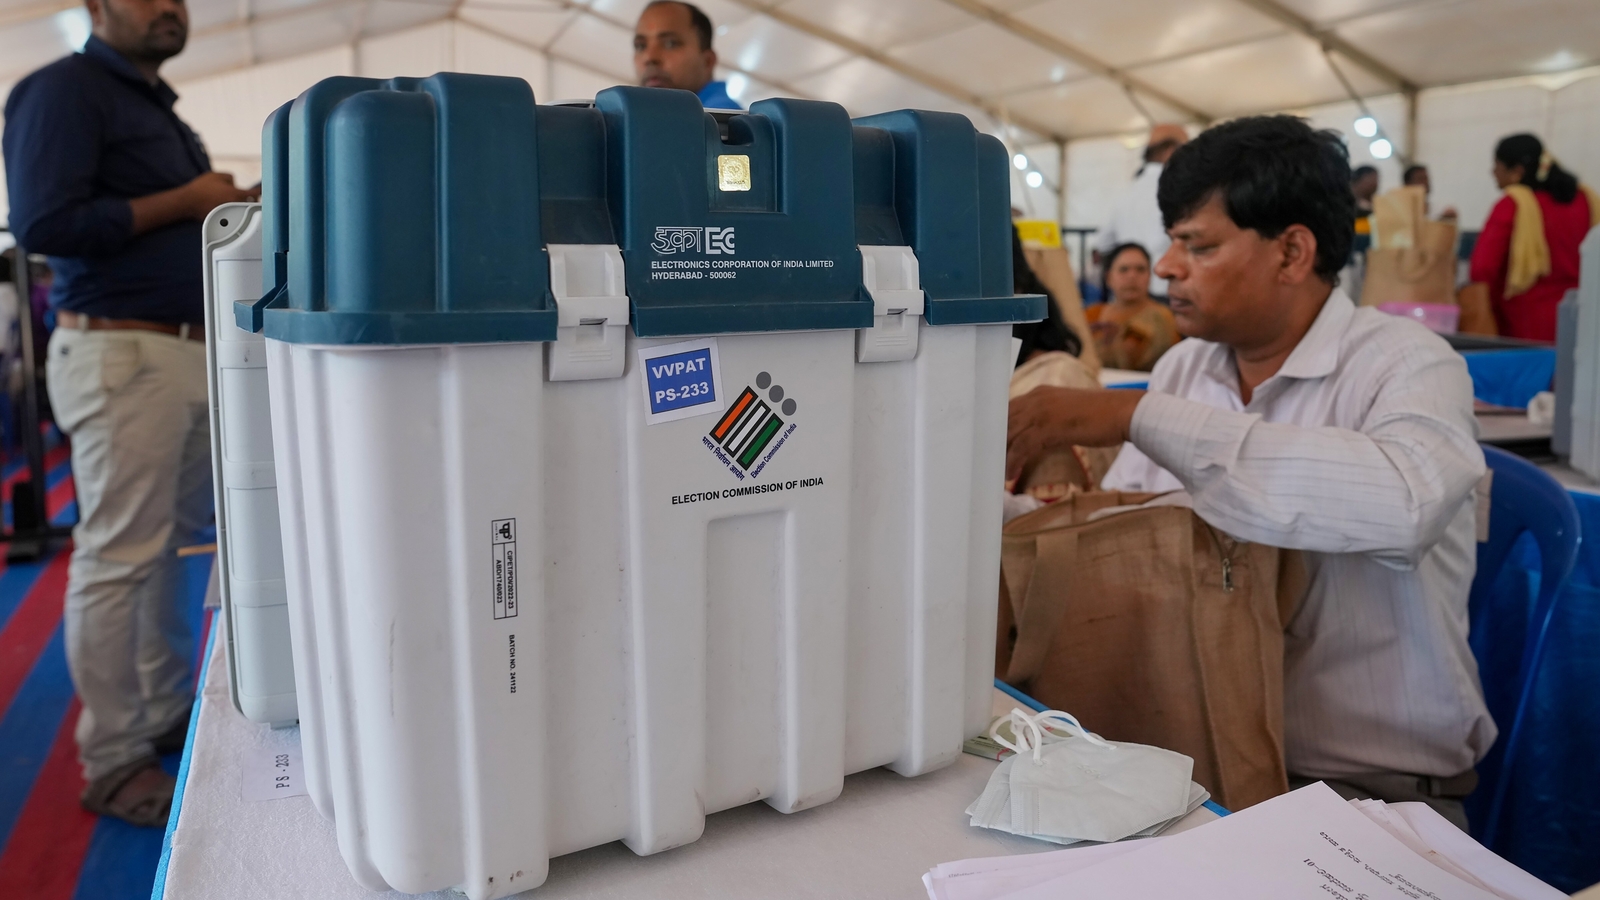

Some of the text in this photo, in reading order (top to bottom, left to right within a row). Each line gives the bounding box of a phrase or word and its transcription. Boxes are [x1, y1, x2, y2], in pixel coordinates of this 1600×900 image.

[651, 260, 834, 269] ELECTRONICS CORPORATION OF INDIA LIMITED
[651, 271, 703, 280] HYDERABAD
[709, 271, 737, 279] 500062
[652, 357, 706, 379] VVPAT
[655, 381, 709, 404] PS-233
[750, 423, 797, 479] Election Commission of India
[671, 476, 824, 505] ELECTION COMMISSION OF INDIA
[508, 634, 516, 658] BATCH
[509, 672, 517, 694] 241122
[275, 754, 289, 768] 233
